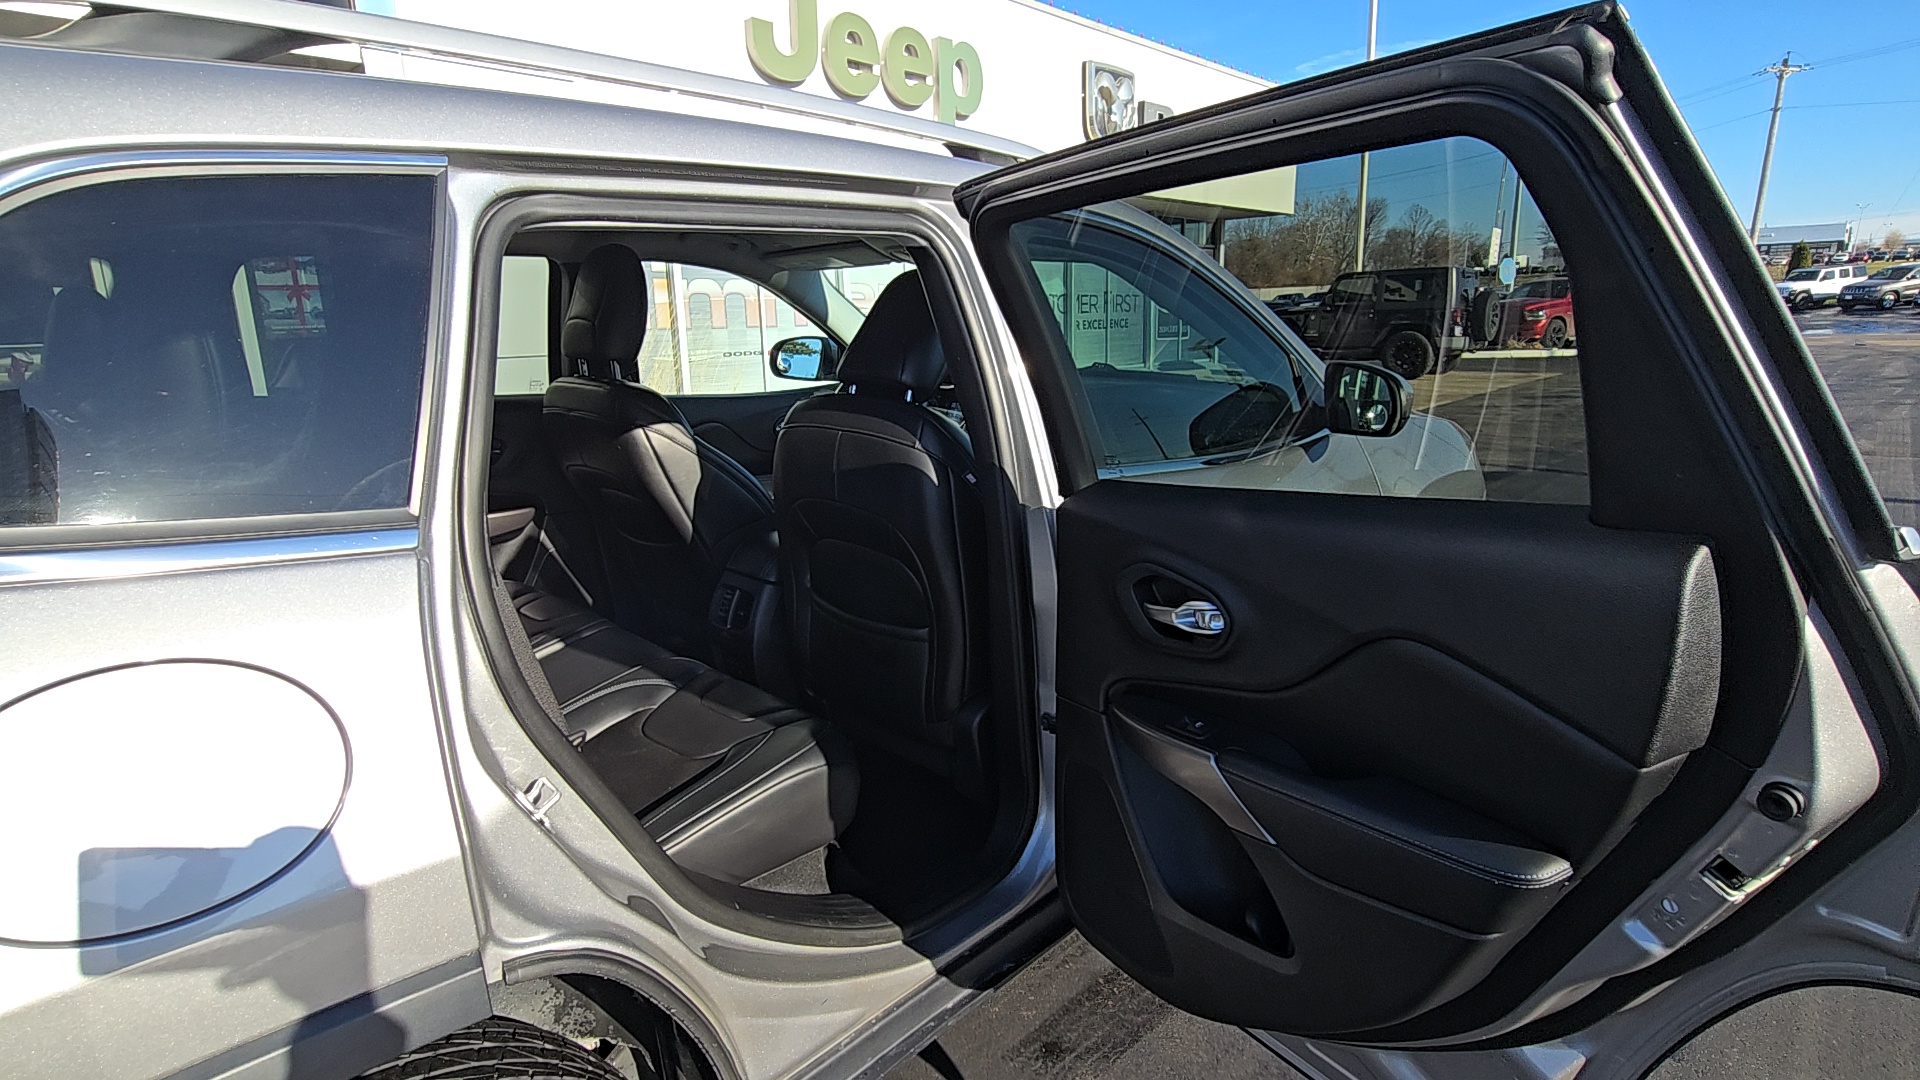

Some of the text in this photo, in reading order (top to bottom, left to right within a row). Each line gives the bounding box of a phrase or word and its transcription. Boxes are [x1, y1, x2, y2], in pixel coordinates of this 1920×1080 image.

[745, 0, 984, 125] Jeep
[1083, 318, 1129, 330] EXCELENCE
[723, 350, 764, 358] DODG
